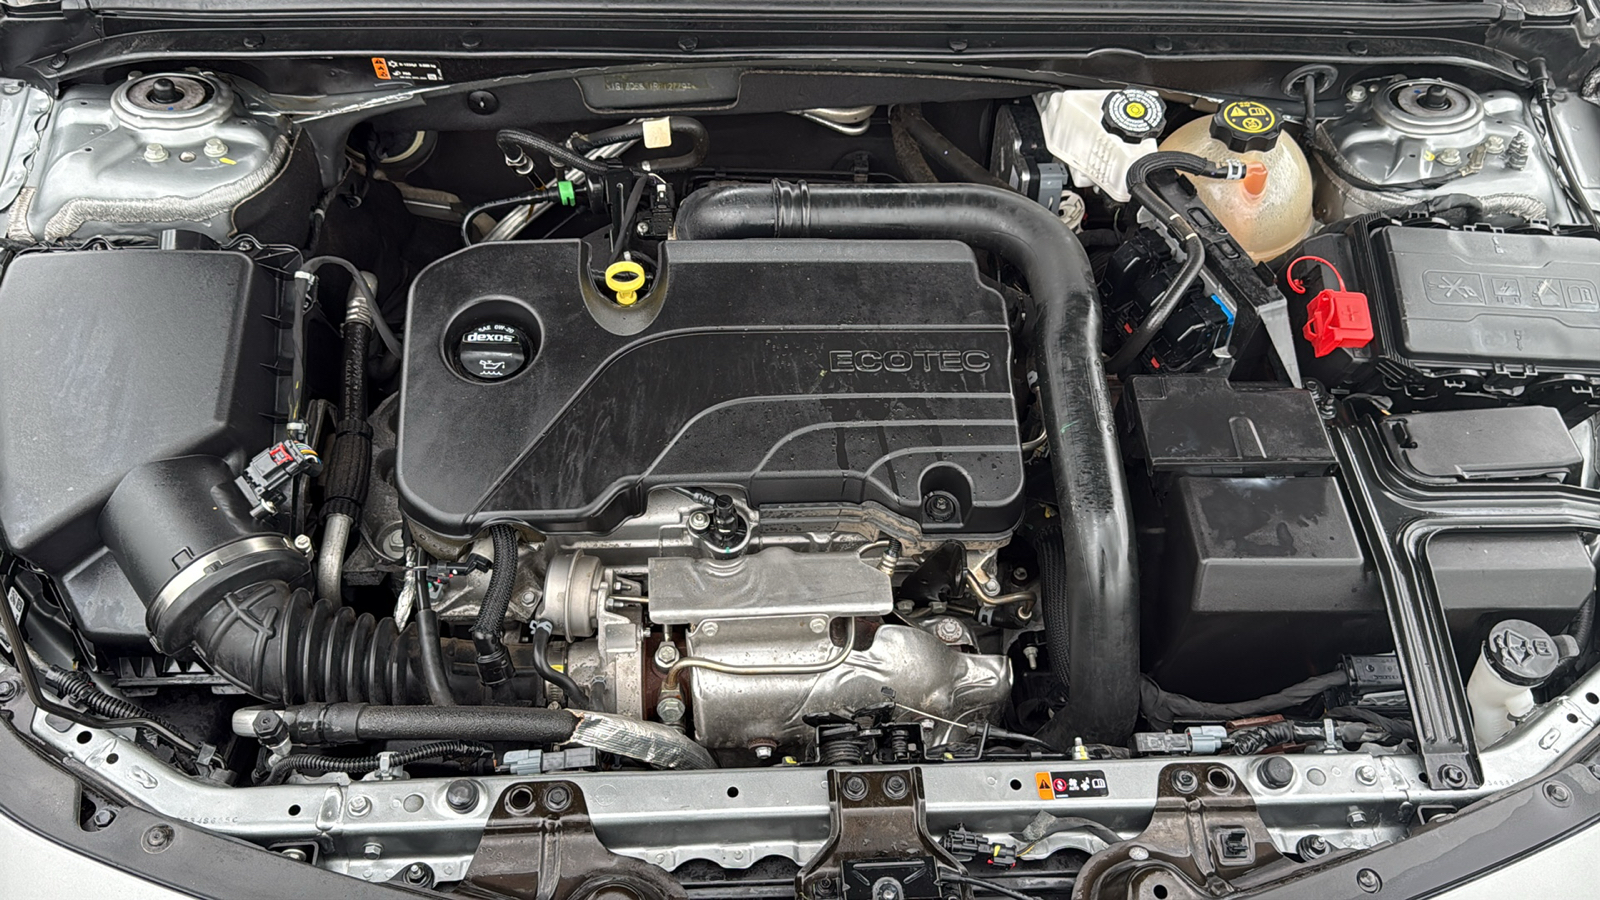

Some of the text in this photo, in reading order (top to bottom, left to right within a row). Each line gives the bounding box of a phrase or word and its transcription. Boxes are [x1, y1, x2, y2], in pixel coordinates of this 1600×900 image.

[478, 324, 515, 334] SAE 0W-20
[467, 332, 515, 342] dexos
[829, 350, 991, 373] ECOTEC
